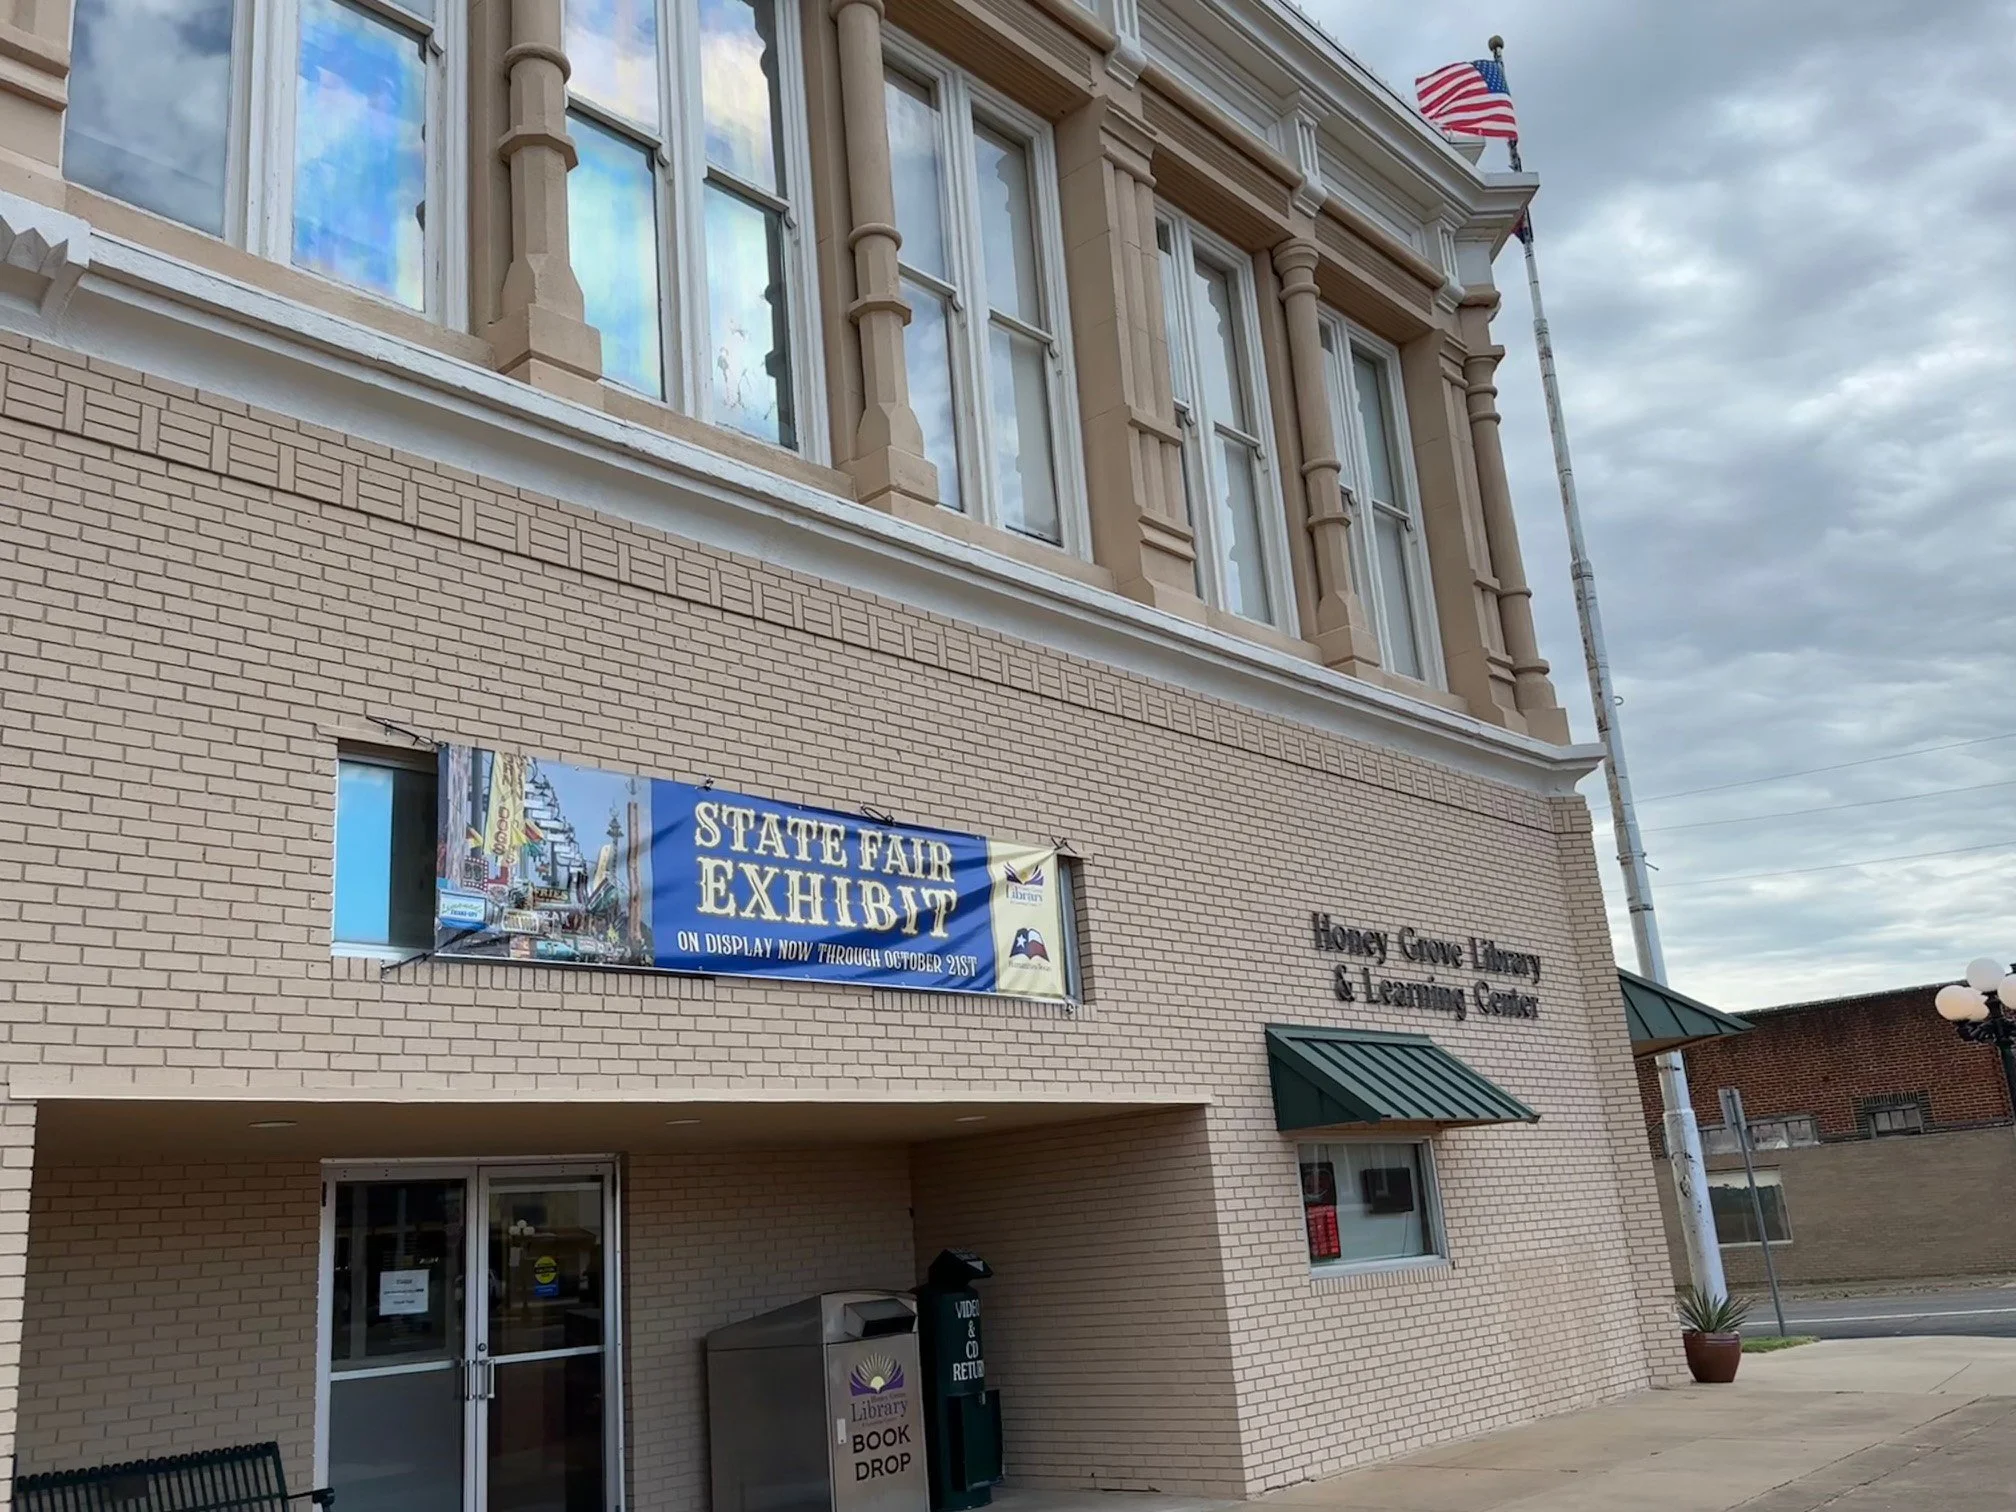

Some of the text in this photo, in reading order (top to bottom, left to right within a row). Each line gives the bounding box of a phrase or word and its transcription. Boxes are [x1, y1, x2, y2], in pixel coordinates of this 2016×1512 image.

[694, 800, 956, 884] STATE FAIR
[695, 856, 958, 939] EXHIBIT
[677, 930, 700, 952] ON
[705, 932, 773, 959] DISPLAY
[778, 938, 815, 963] NOW
[817, 942, 881, 969] THROUGH
[884, 950, 943, 974] OCTOBER
[947, 954, 978, 978] 21ST
[1312, 911, 1541, 985] Honey Grove Library
[1334, 964, 1540, 1021] & Learning Center
[967, 1319, 976, 1338] &
[965, 1340, 979, 1360] CD
[850, 1399, 908, 1422] Library
[852, 1423, 912, 1454] BOOK
[855, 1452, 912, 1482] DROP
